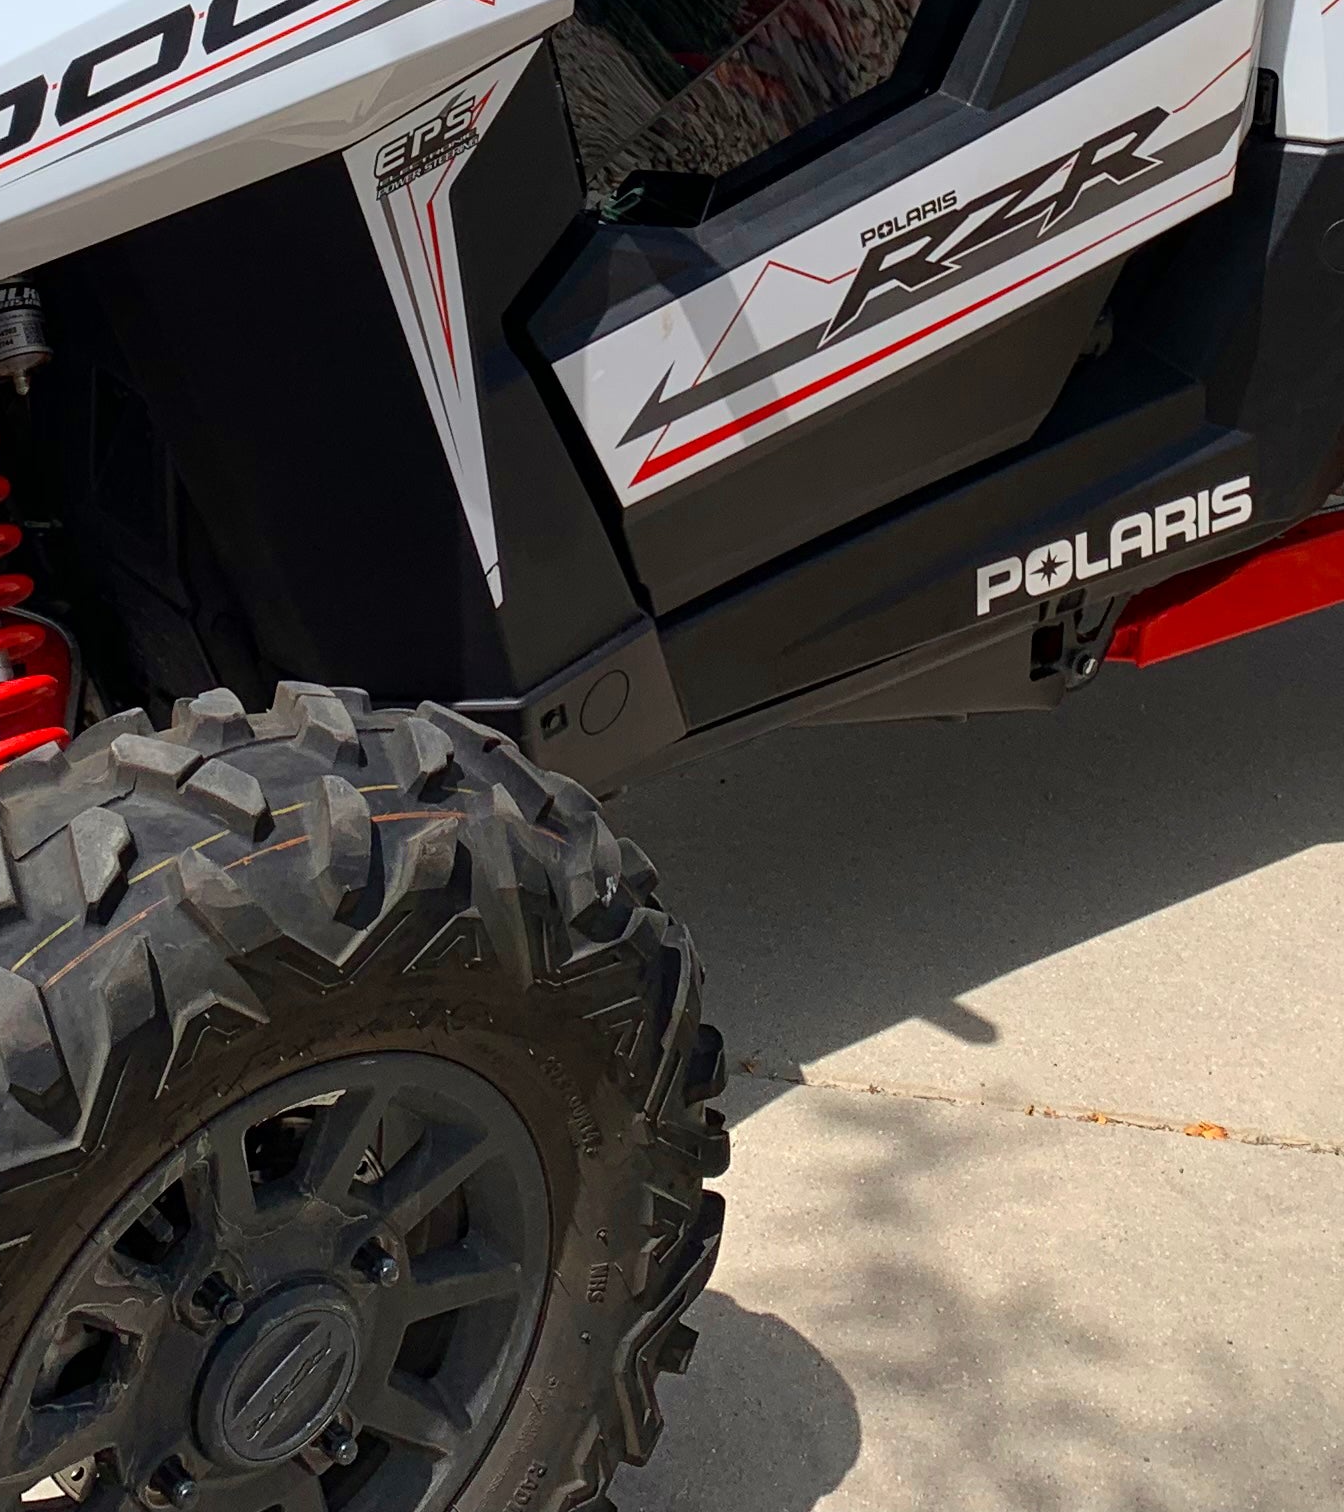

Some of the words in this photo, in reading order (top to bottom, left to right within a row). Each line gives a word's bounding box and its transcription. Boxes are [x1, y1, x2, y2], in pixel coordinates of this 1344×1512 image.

[374, 94, 477, 179] EPS
[376, 167, 423, 200] POWER
[423, 134, 480, 173] STEERING
[378, 130, 476, 188] ELECTRONIC
[817, 105, 1171, 349] RZR
[859, 190, 958, 248] POLARIS
[975, 476, 1253, 616] POLARIS
